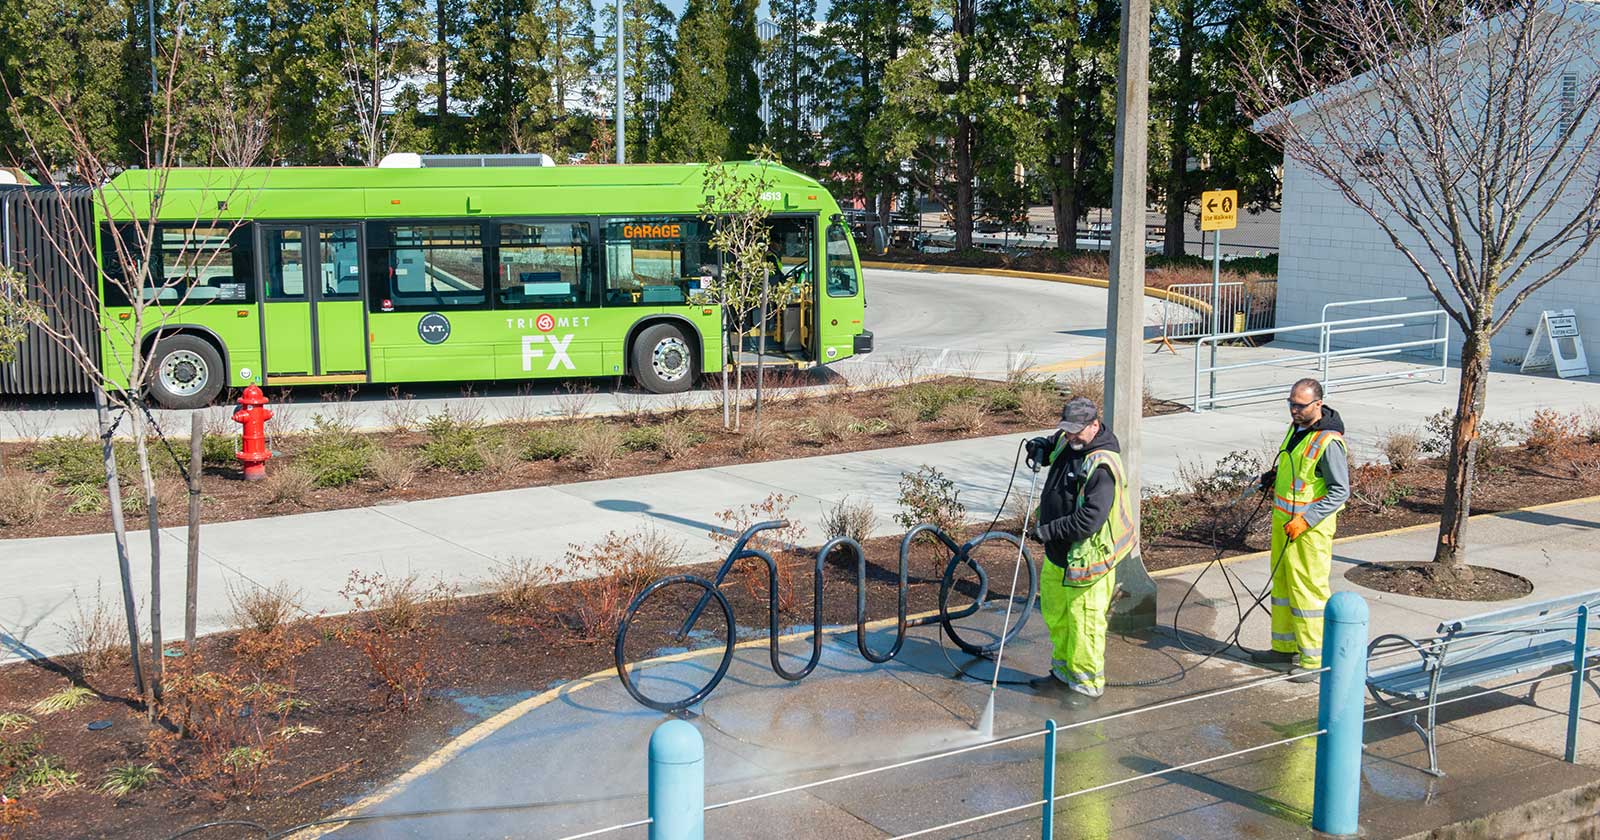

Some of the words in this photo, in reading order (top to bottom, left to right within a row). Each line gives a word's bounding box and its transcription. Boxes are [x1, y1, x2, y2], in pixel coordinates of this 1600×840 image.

[760, 191, 782, 201] 4513
[623, 224, 681, 238] GARAGE
[521, 334, 577, 371] FX
